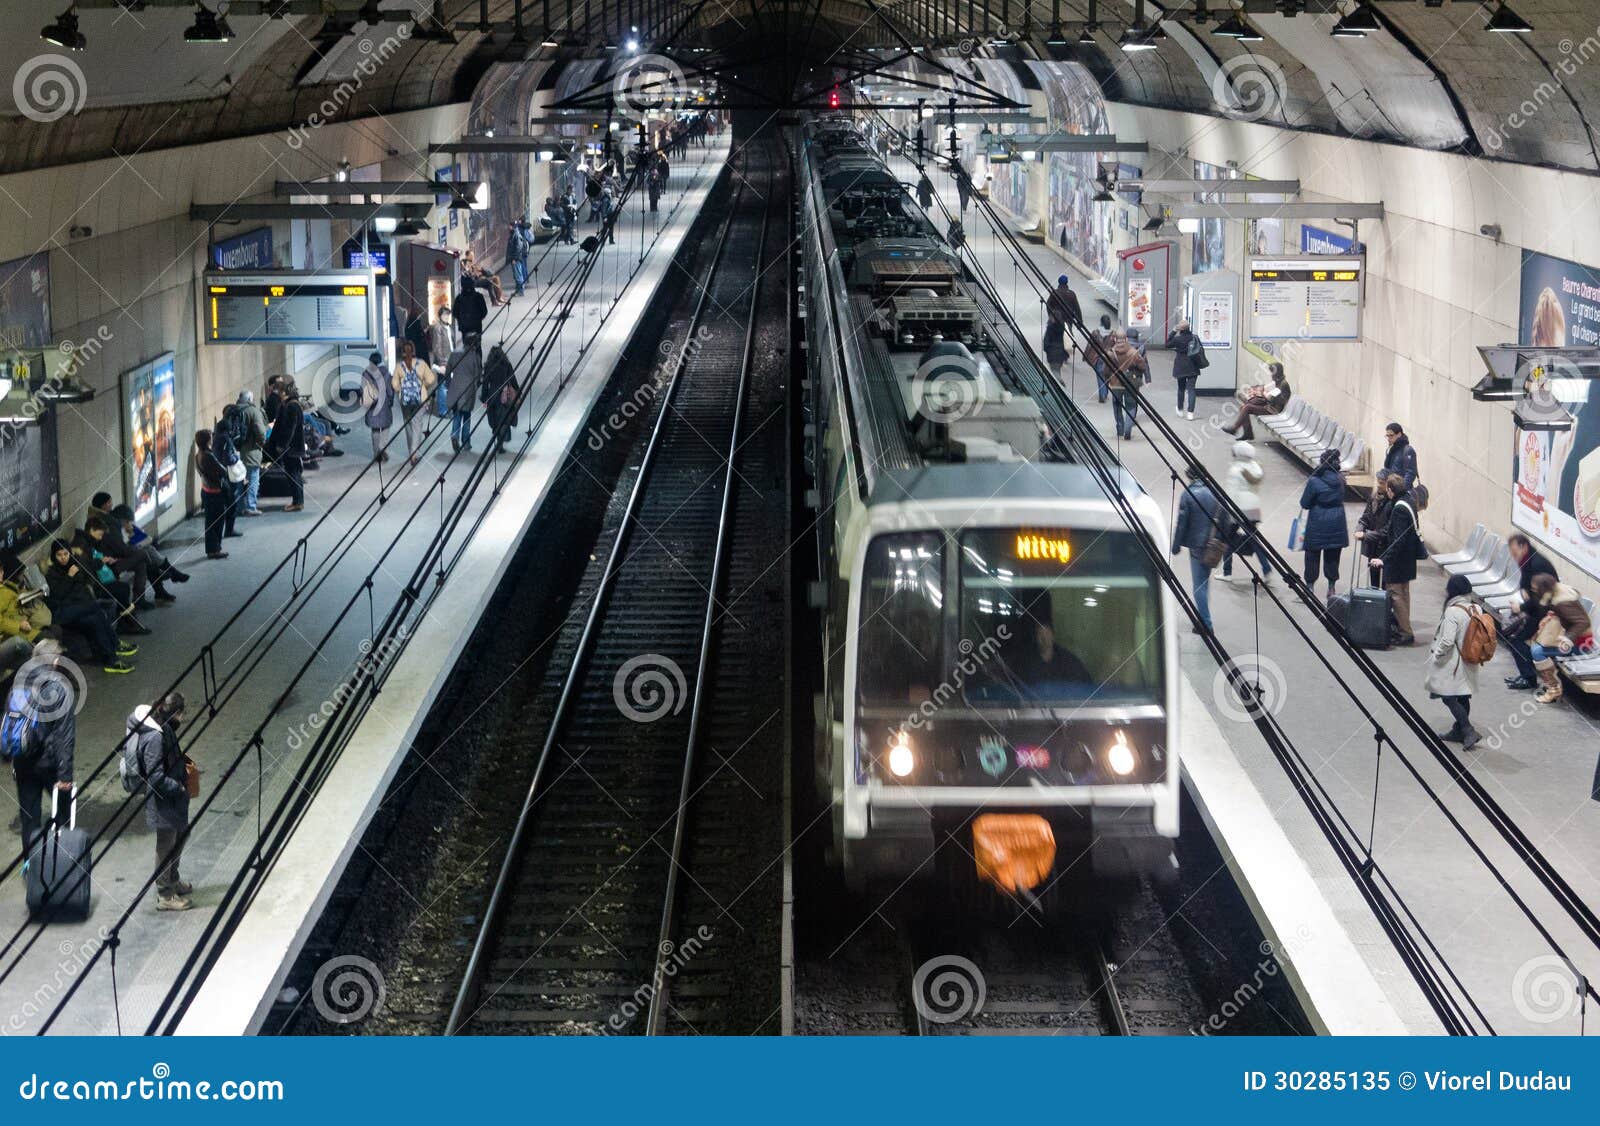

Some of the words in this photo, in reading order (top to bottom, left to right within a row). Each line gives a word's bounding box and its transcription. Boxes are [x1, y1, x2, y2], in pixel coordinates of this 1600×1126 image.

[1562, 276, 1580, 296] Beurre
[1570, 298, 1578, 314] Le
[1578, 303, 1594, 323] grand
[1016, 535, 1071, 563] Mitry
